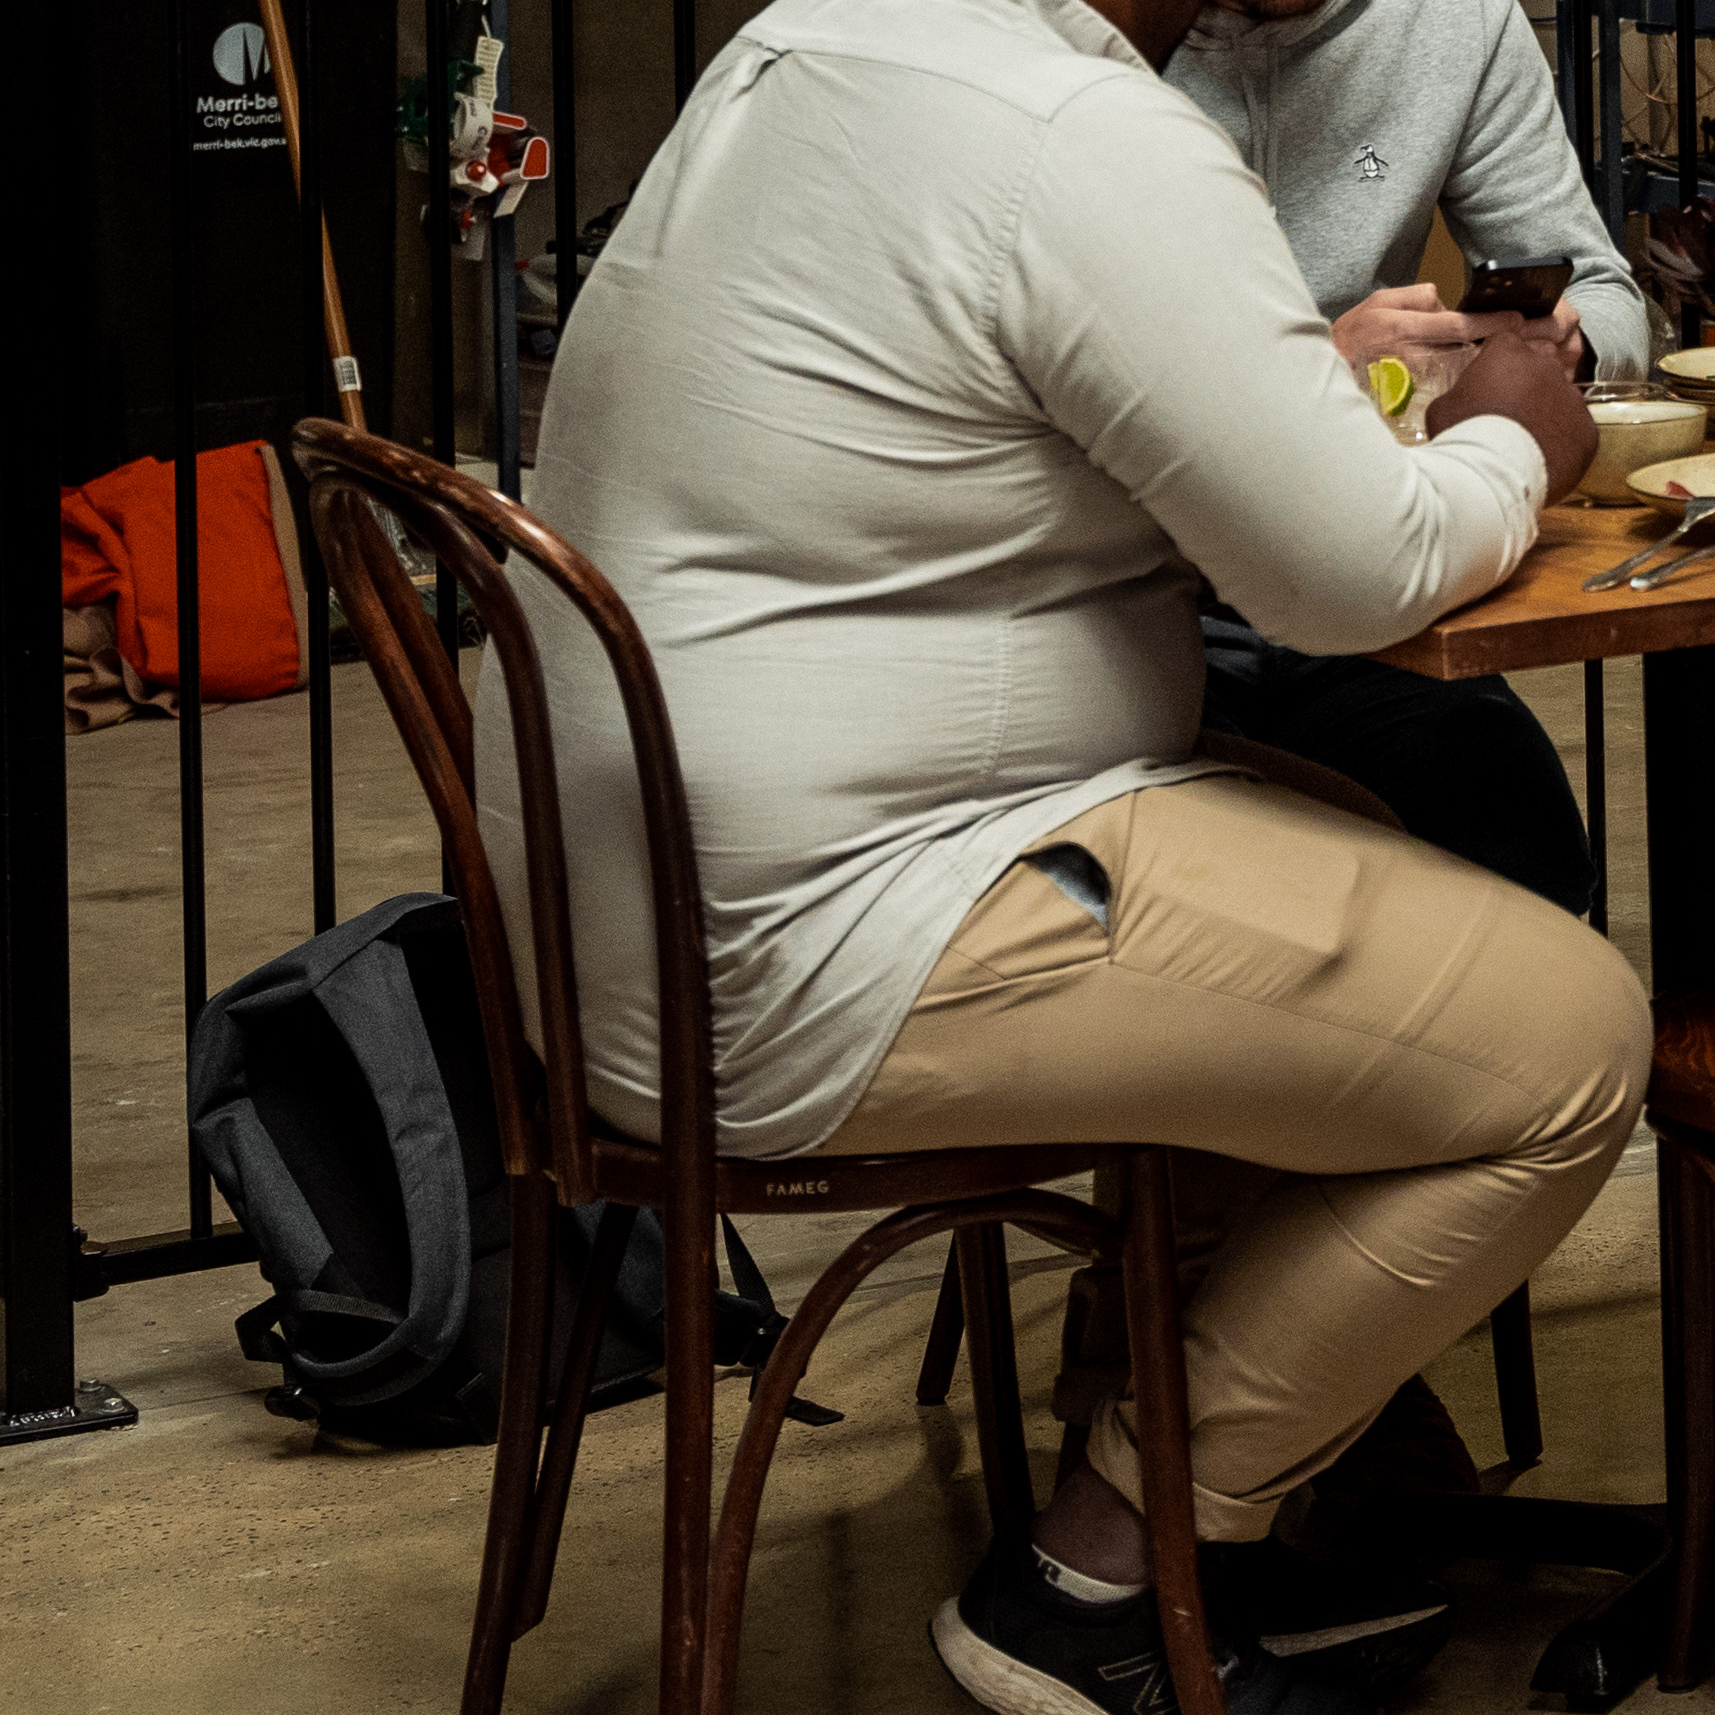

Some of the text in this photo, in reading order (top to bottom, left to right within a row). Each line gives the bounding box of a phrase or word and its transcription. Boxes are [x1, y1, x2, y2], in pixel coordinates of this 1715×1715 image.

[197, 93, 278, 113] Merri-be
[203, 115, 230, 129] City
[766, 1180, 829, 1196] FAMEG
